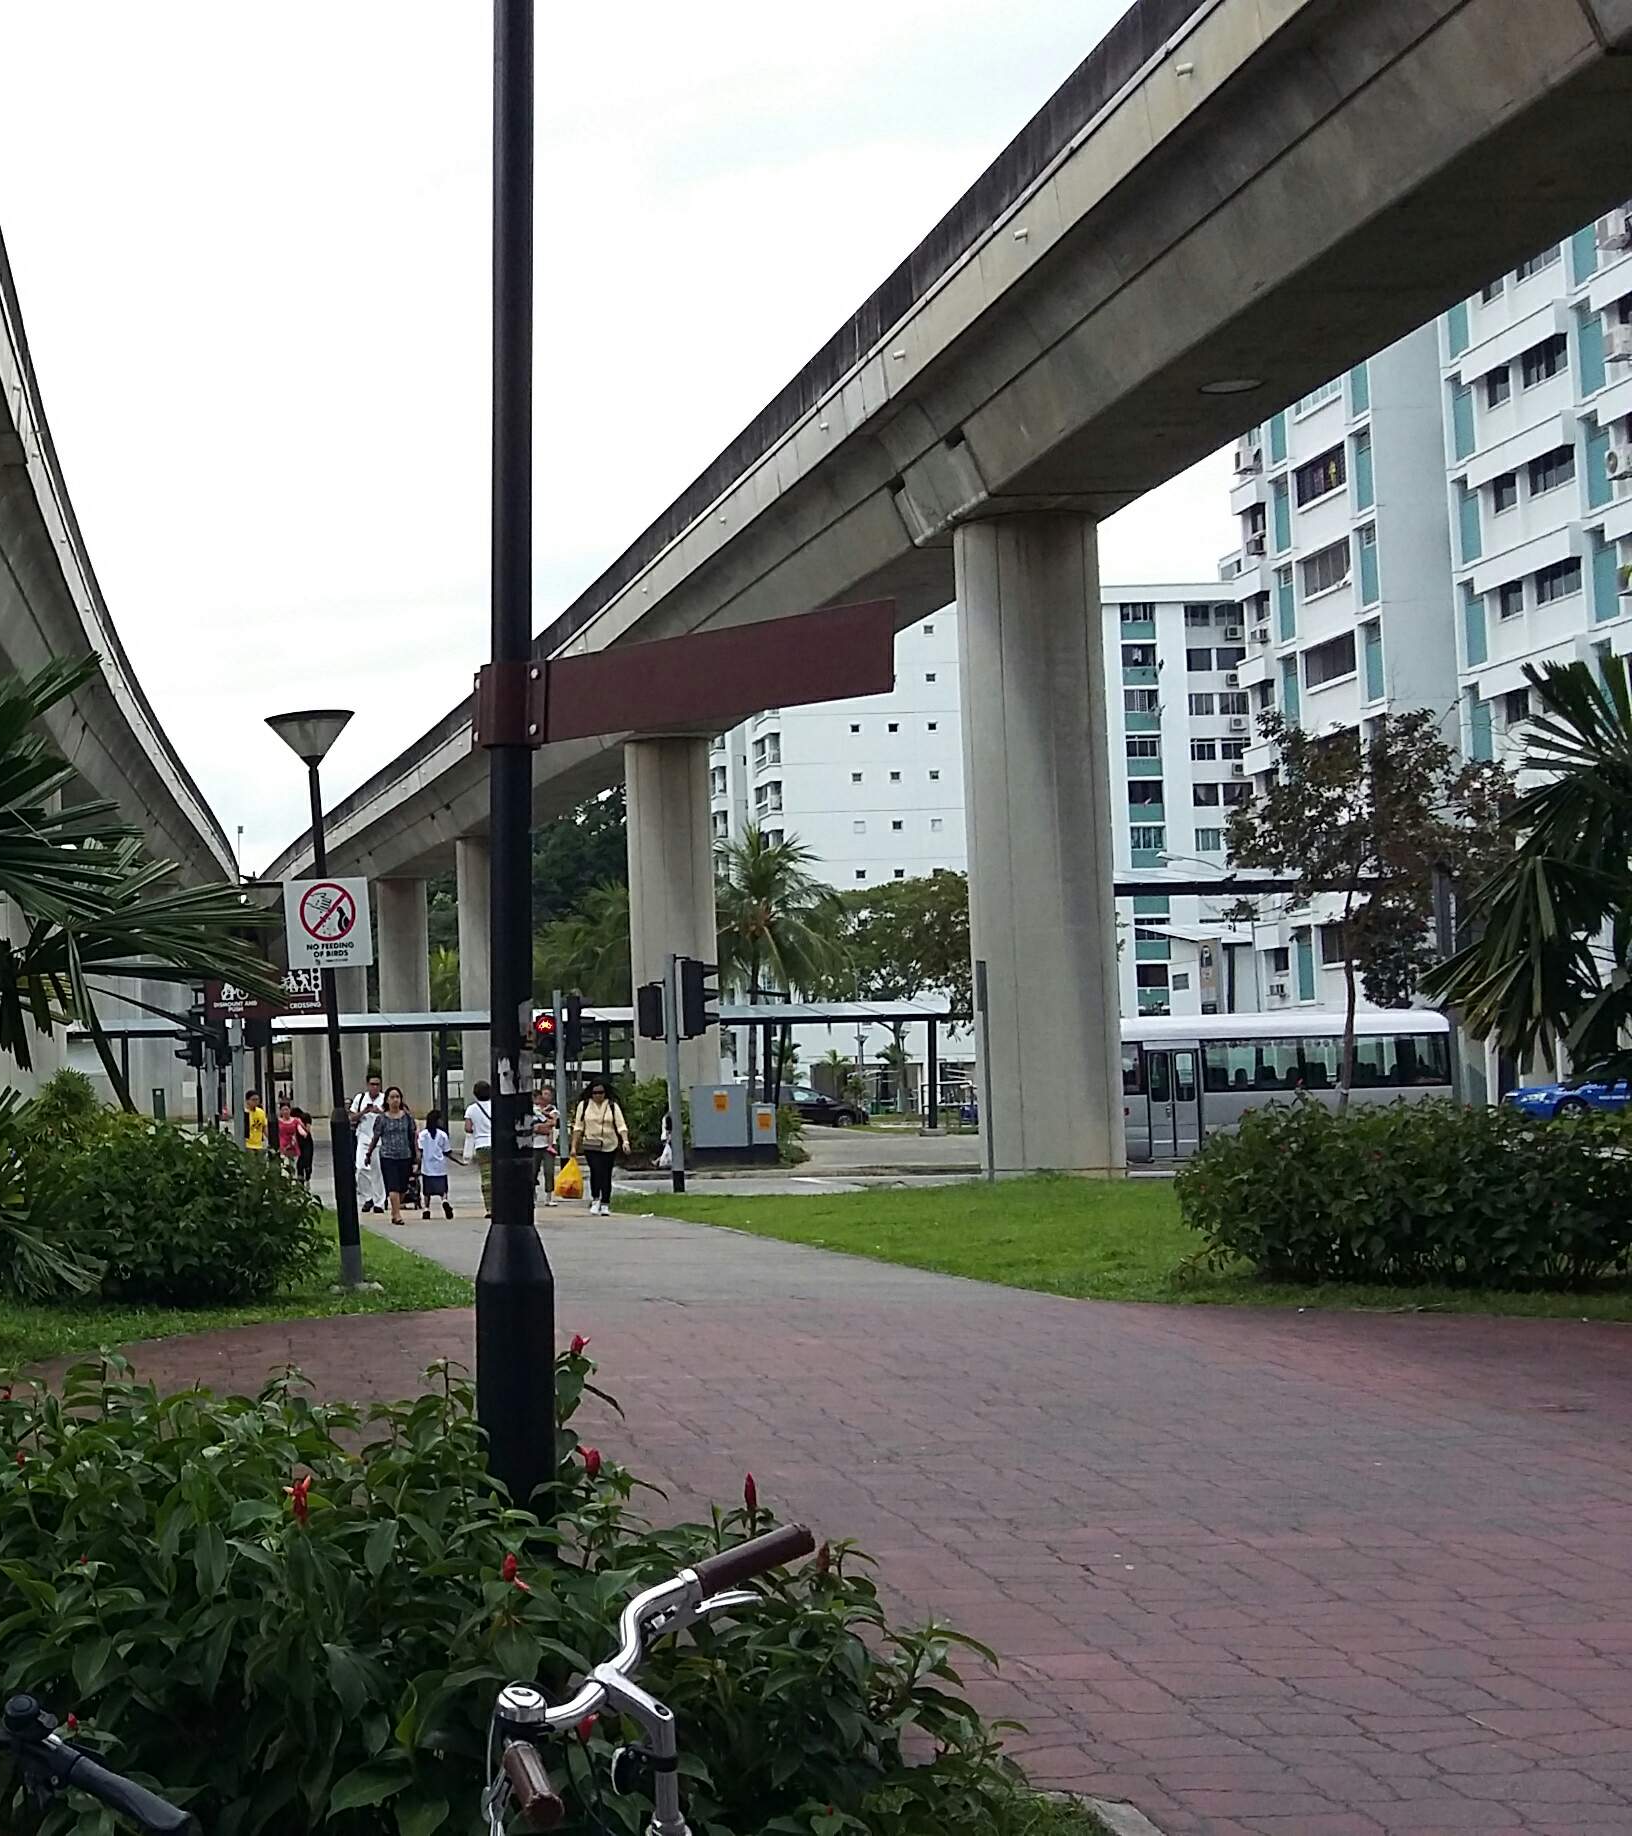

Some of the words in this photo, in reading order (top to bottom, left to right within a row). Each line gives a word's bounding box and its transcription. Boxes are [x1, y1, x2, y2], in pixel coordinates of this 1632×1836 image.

[306, 943, 320, 951] NO
[321, 941, 355, 950] FEEDING
[313, 950, 324, 958] OF
[326, 949, 349, 957] BIRDS
[213, 1000, 244, 1008] DISMOUNT
[289, 1000, 322, 1009] CROSSING
